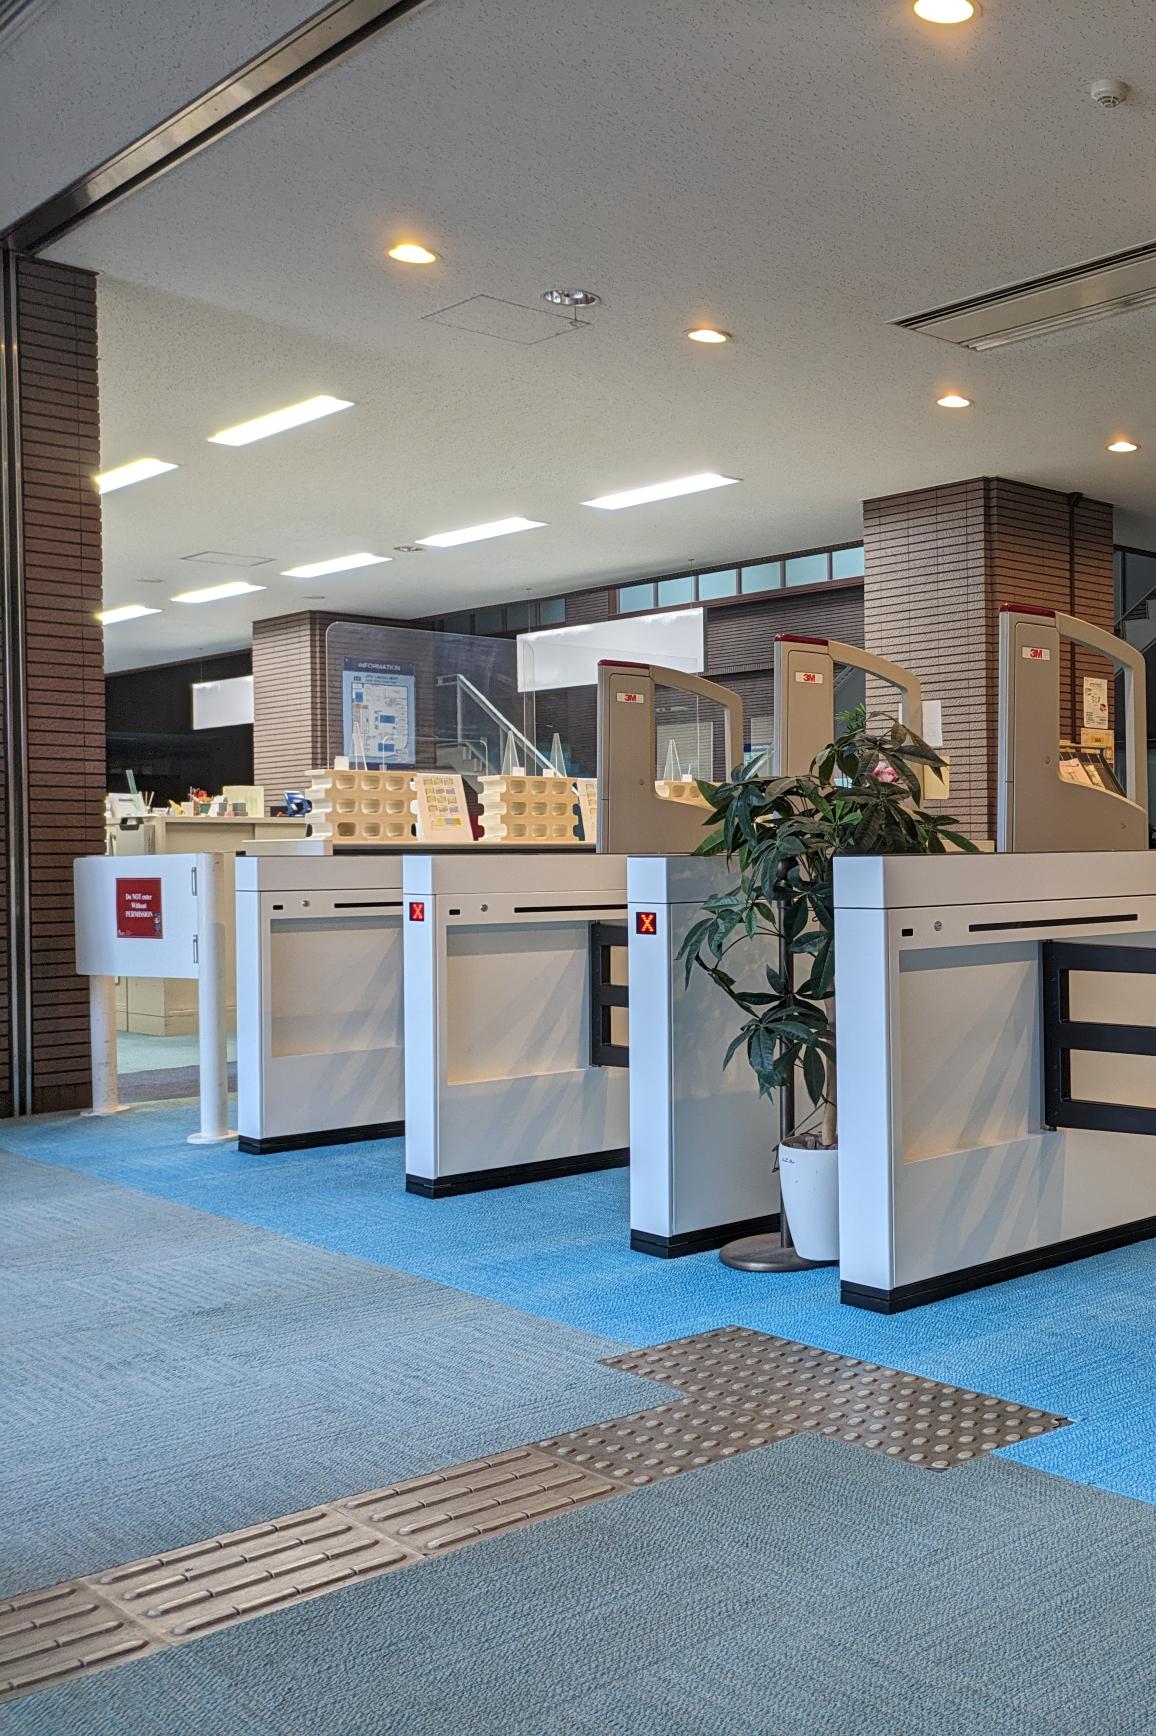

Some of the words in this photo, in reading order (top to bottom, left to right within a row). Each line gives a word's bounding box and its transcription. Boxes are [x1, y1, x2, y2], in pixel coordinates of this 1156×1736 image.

[1030, 649, 1043, 659] 3M
[803, 674, 816, 682] 3M
[624, 694, 637, 702] 3M
